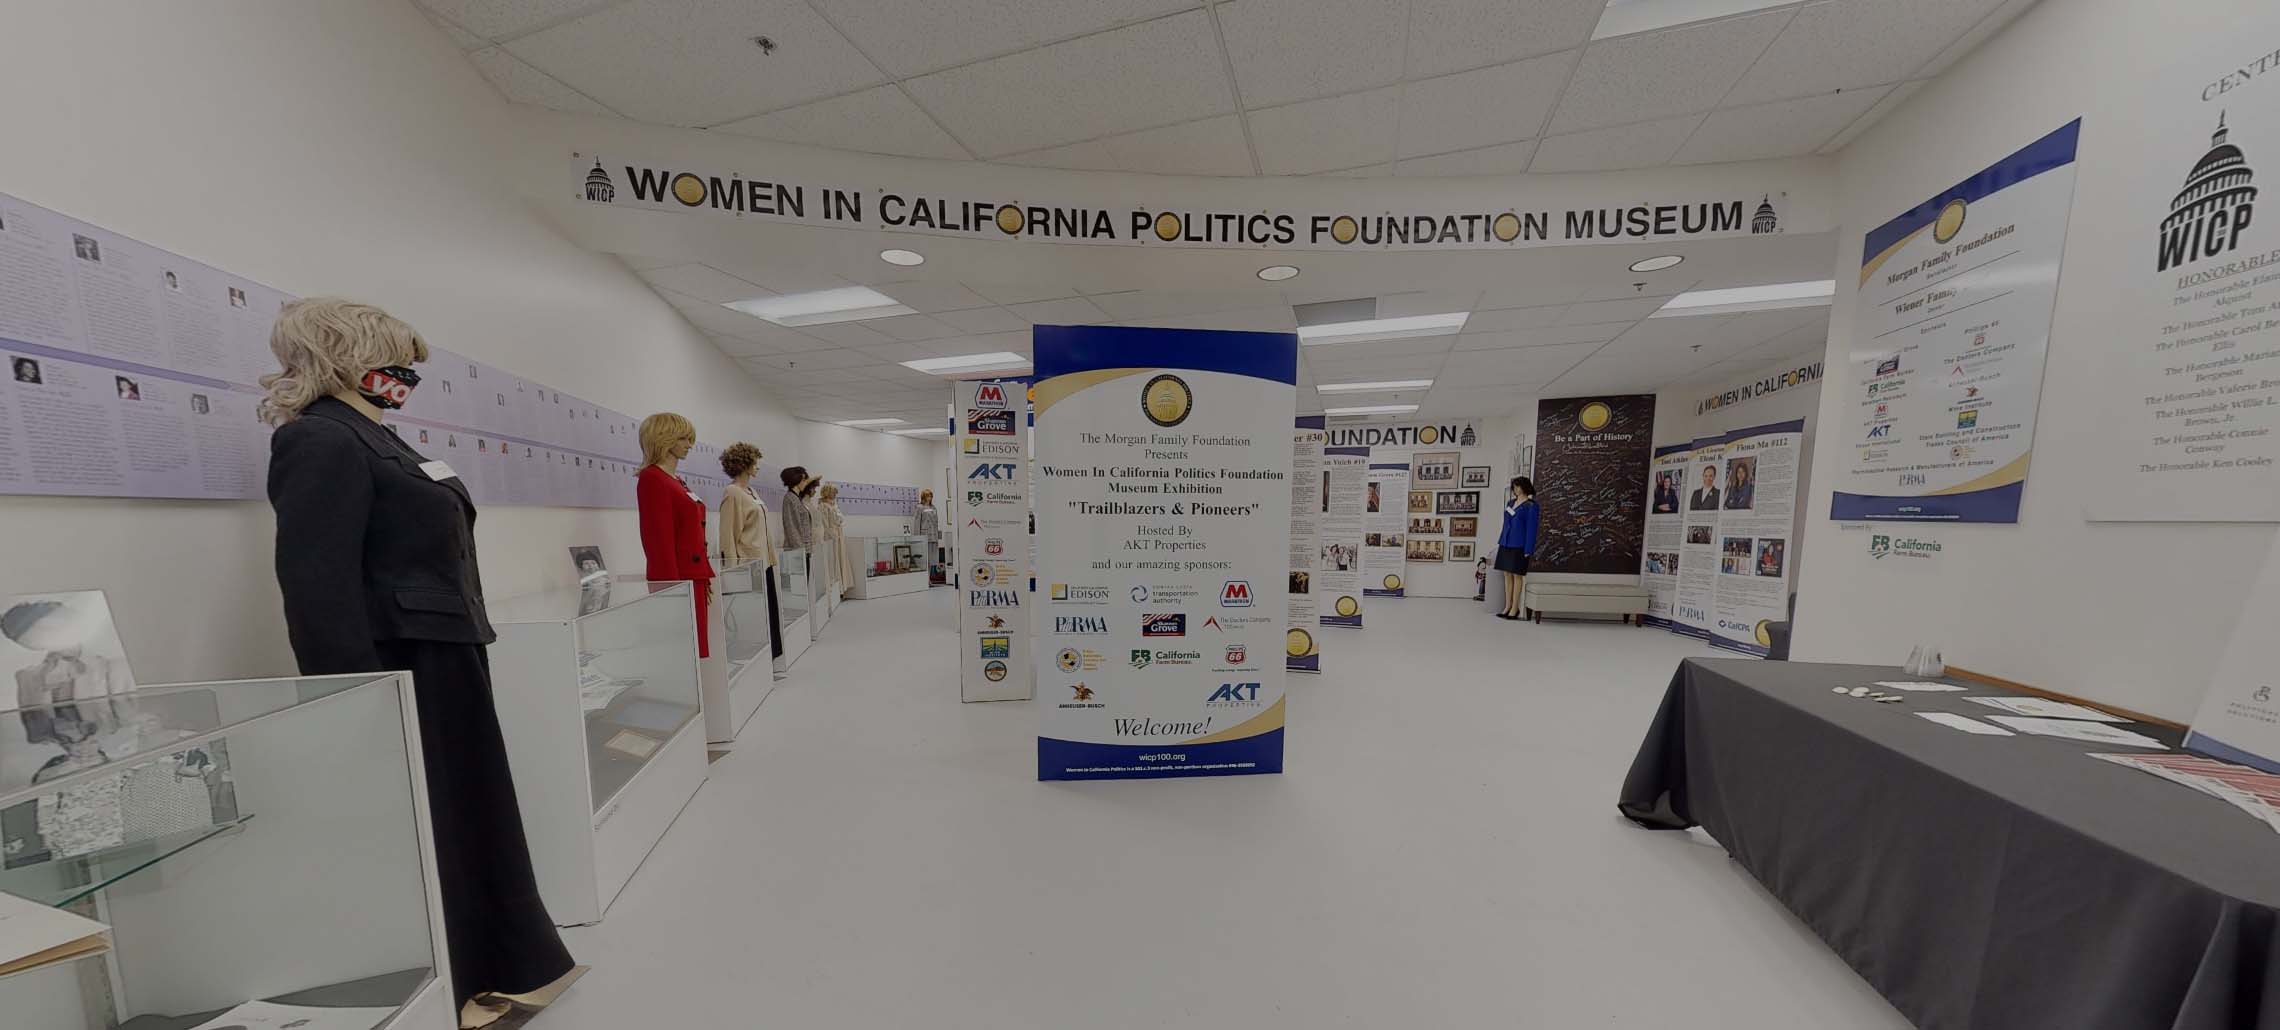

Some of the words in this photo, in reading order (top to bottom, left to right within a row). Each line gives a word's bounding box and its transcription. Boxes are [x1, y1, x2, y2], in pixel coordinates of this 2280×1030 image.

[586, 187, 615, 203] WICP
[625, 166, 804, 217] WOMEN
[823, 189, 862, 222] IN
[880, 194, 1115, 239] CALIFORNIA
[1131, 211, 1295, 244] POLITICS
[1311, 211, 1547, 245] FOUNDATION
[1565, 201, 1743, 240] MUSEUM
[1752, 221, 1776, 234] WICP
[2158, 203, 2253, 272] WICP
[1887, 266, 1919, 285] Morgan
[1921, 250, 1953, 271] Family
[1956, 224, 2015, 256] Foundation
[1741, 384, 1751, 400] IN
[977, 420, 1007, 431] Grove
[1867, 424, 1891, 439] AKT
[1080, 432, 1101, 444] The
[1105, 432, 1147, 447] Morgan
[1150, 433, 1188, 448] Family
[1192, 434, 1251, 447] Foundation
[1306, 433, 1323, 443] #30
[1554, 434, 1566, 442] Be
[1575, 434, 1591, 442] Part
[1592, 433, 1603, 441] of
[1604, 432, 1633, 443] History
[982, 445, 1020, 454] EDISON
[1144, 448, 1189, 460] Presents
[1736, 444, 1755, 452] Fiona
[968, 463, 1017, 479] AKT
[1042, 466, 1088, 478] Women
[1093, 466, 1105, 478] In
[1110, 466, 1170, 479] California
[1174, 467, 1216, 480] Politics
[1220, 469, 1284, 481] Foundation
[1108, 482, 1158, 494] Museum
[1163, 482, 1223, 495] Exhibition
[986, 492, 1022, 501] California
[1068, 501, 1166, 516] "Trailblazers
[1171, 503, 1184, 515] &
[1191, 502, 1260, 516] Pioneers"
[1137, 525, 1173, 536] Hosted
[1178, 525, 1193, 538] By
[1123, 539, 1150, 550] AKT
[1154, 539, 1207, 552] Properties
[1894, 538, 1942, 552] California
[1091, 559, 1111, 570] and
[1115, 561, 1133, 570] our
[1136, 560, 1180, 572] amazing
[1184, 560, 1232, 572] sponsors:
[1070, 590, 1110, 599] EDISON
[1152, 589, 1200, 599] transportation
[1152, 598, 1182, 606] authority
[1151, 623, 1178, 633] Grove
[1131, 649, 1152, 663] FB
[1155, 650, 1201, 660] California
[1229, 652, 1243, 661] 66
[1207, 683, 1261, 702] AKT
[1114, 716, 1211, 737] Welcome!
[1138, 751, 1187, 762] wicp100.org
